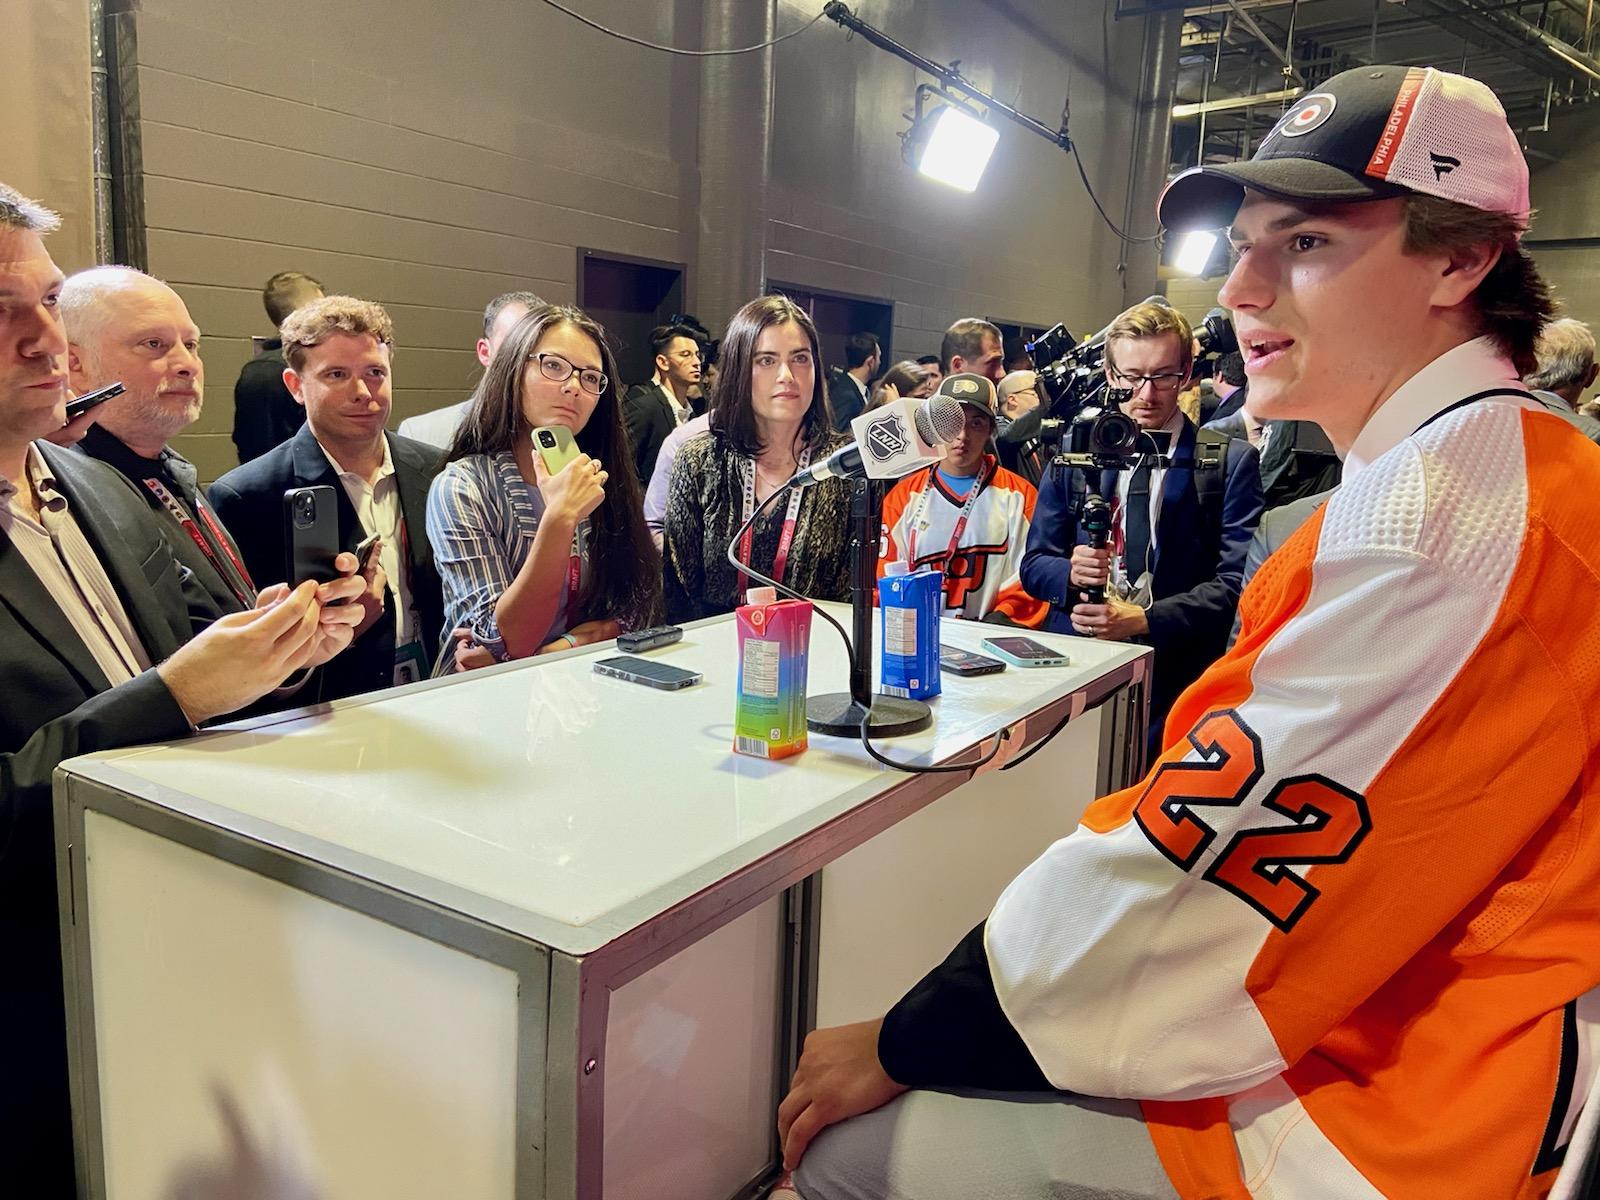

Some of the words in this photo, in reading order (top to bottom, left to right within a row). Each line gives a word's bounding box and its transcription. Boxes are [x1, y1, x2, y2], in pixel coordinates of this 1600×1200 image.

[1374, 89, 1412, 165] PHILADELPHIA
[571, 568, 580, 591] DRAFT
[1133, 708, 1373, 934] 22
